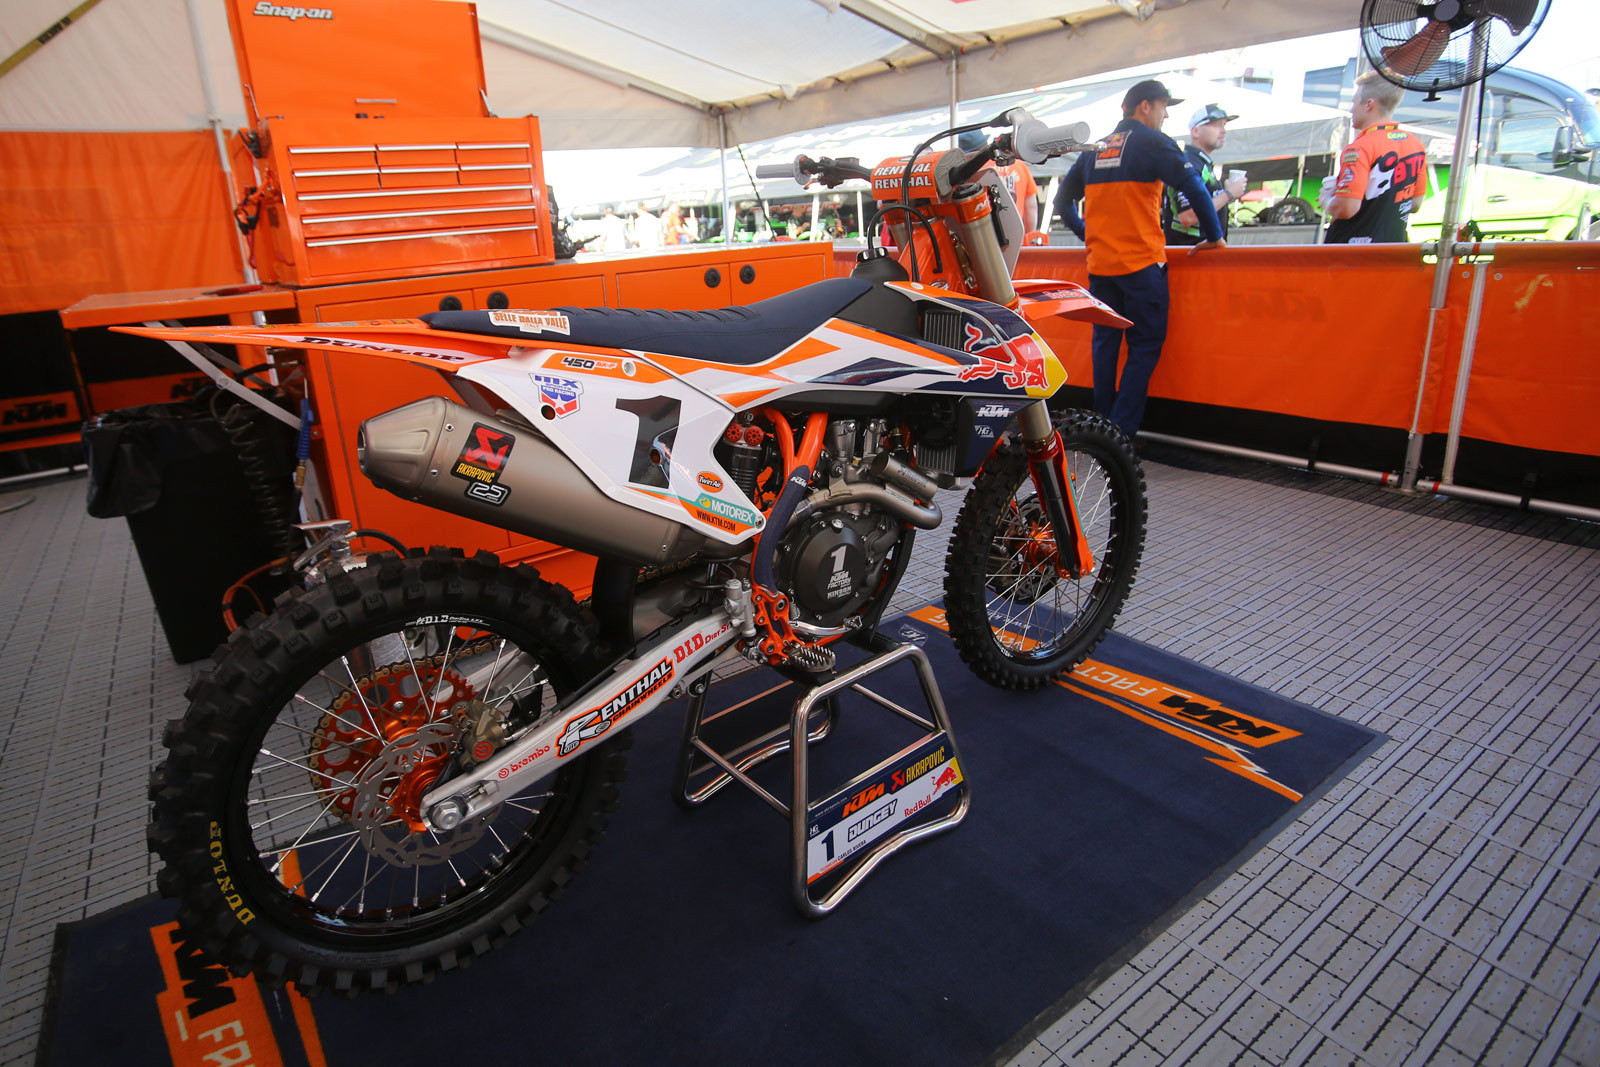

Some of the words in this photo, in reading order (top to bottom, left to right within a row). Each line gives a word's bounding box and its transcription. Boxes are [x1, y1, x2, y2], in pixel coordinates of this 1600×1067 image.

[253, 1, 333, 20] Snap-on
[545, 317, 568, 330] VALLE
[299, 336, 465, 362] DUNLOP
[562, 356, 595, 369] 450
[2, 401, 67, 425] KTM
[976, 404, 1014, 418] KTM
[615, 395, 682, 489] 1
[699, 475, 713, 487] Twin
[712, 479, 722, 489] Air
[790, 476, 808, 488] KTM
[696, 509, 737, 532] WWW.KTM.COM
[711, 499, 754, 524] MOTOREX
[830, 545, 848, 573] 1
[827, 577, 852, 590] FACTORY
[830, 570, 850, 583] KTM
[1073, 664, 1158, 697] FACT
[612, 672, 674, 722] CHAINWHEELS
[510, 745, 551, 773] brembo
[841, 782, 886, 819] KTM
[847, 798, 898, 843] DUNGEY
[821, 829, 836, 862] 1
[837, 847, 853, 862] CARLOS
[853, 839, 867, 854] RIVERA
[209, 821, 256, 926] DUNLOP
